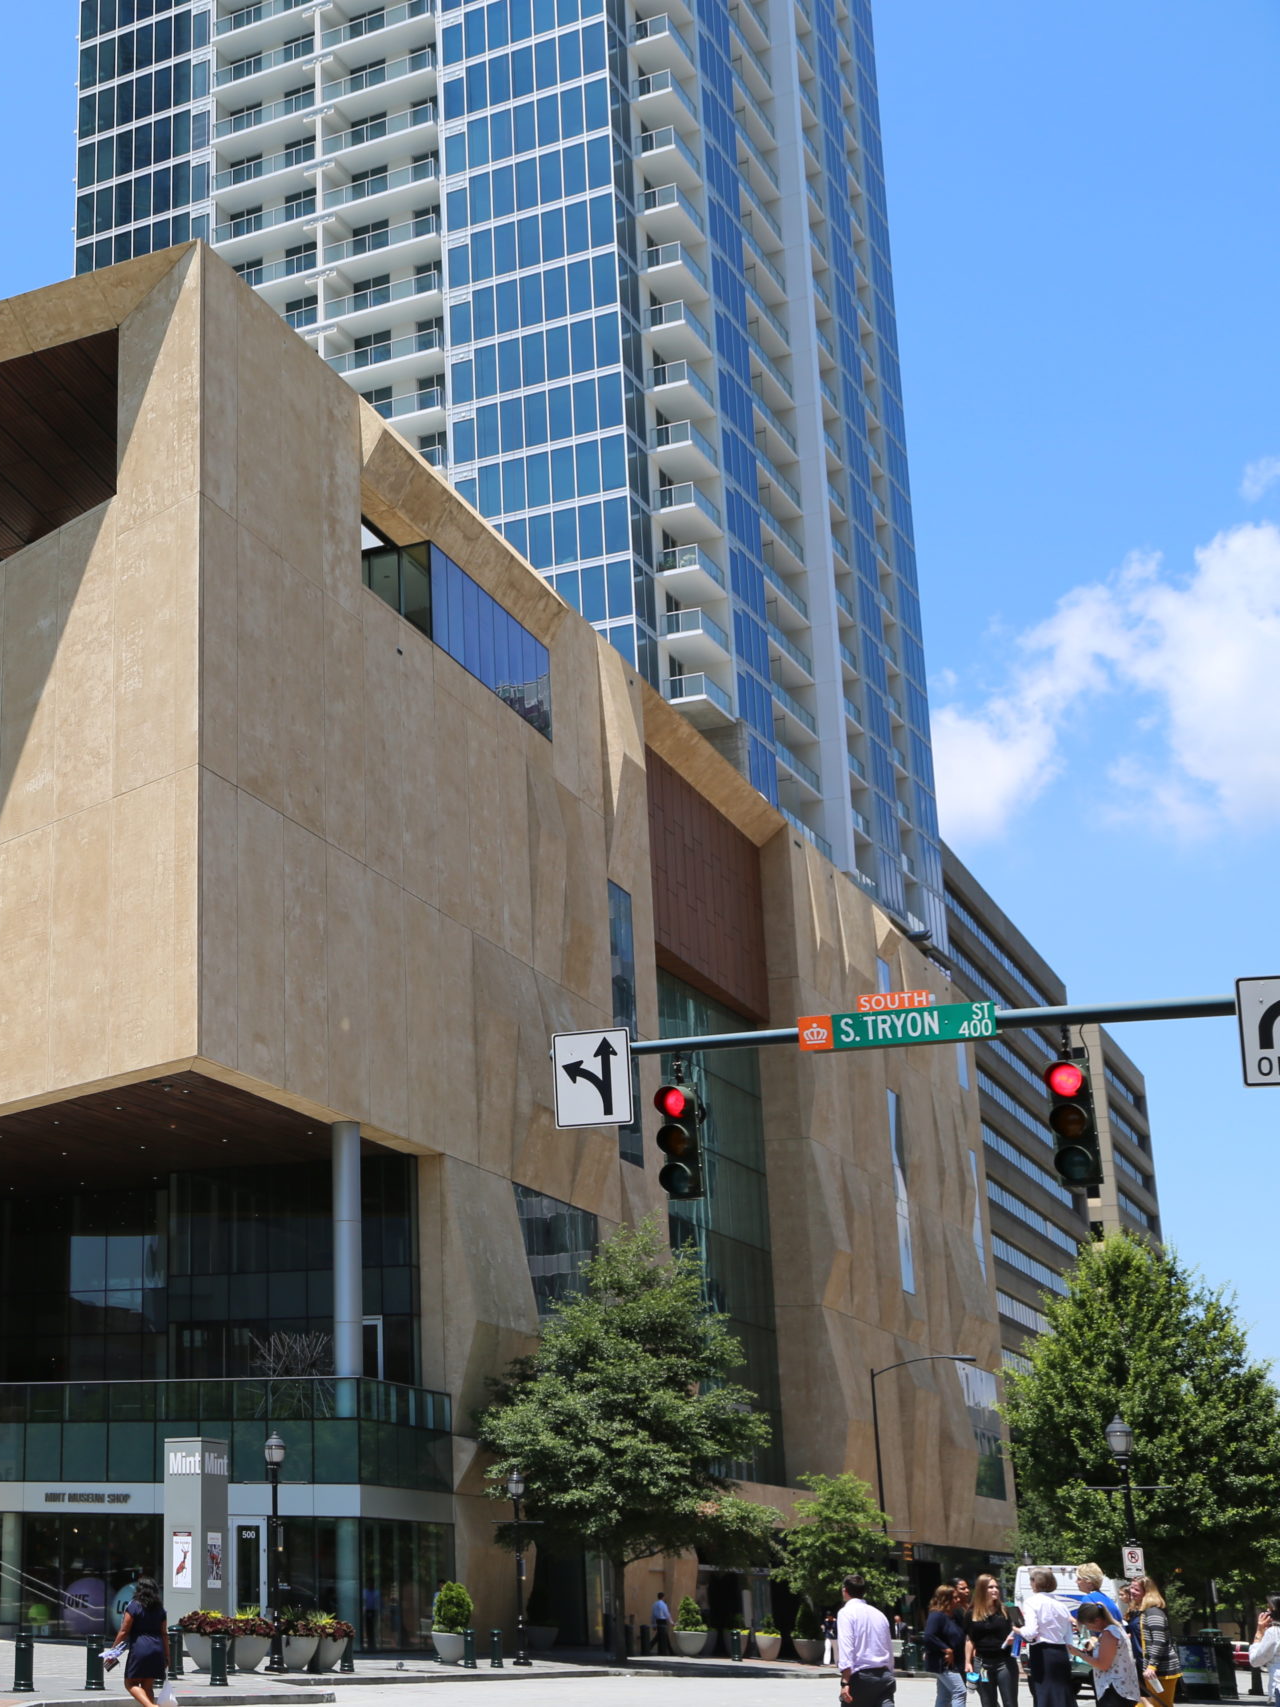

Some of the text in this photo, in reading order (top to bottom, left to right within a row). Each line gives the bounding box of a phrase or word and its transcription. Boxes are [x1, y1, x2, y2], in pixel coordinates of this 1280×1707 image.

[860, 991, 928, 1011] SOUTH
[971, 1002, 991, 1020] ST
[958, 1019, 992, 1038] 400
[1257, 1056, 1280, 1077] O
[169, 1452, 201, 1474] Mint
[204, 1452, 228, 1476] Mint
[68, 1493, 105, 1503] MUSEUM
[107, 1493, 131, 1504] SHOP
